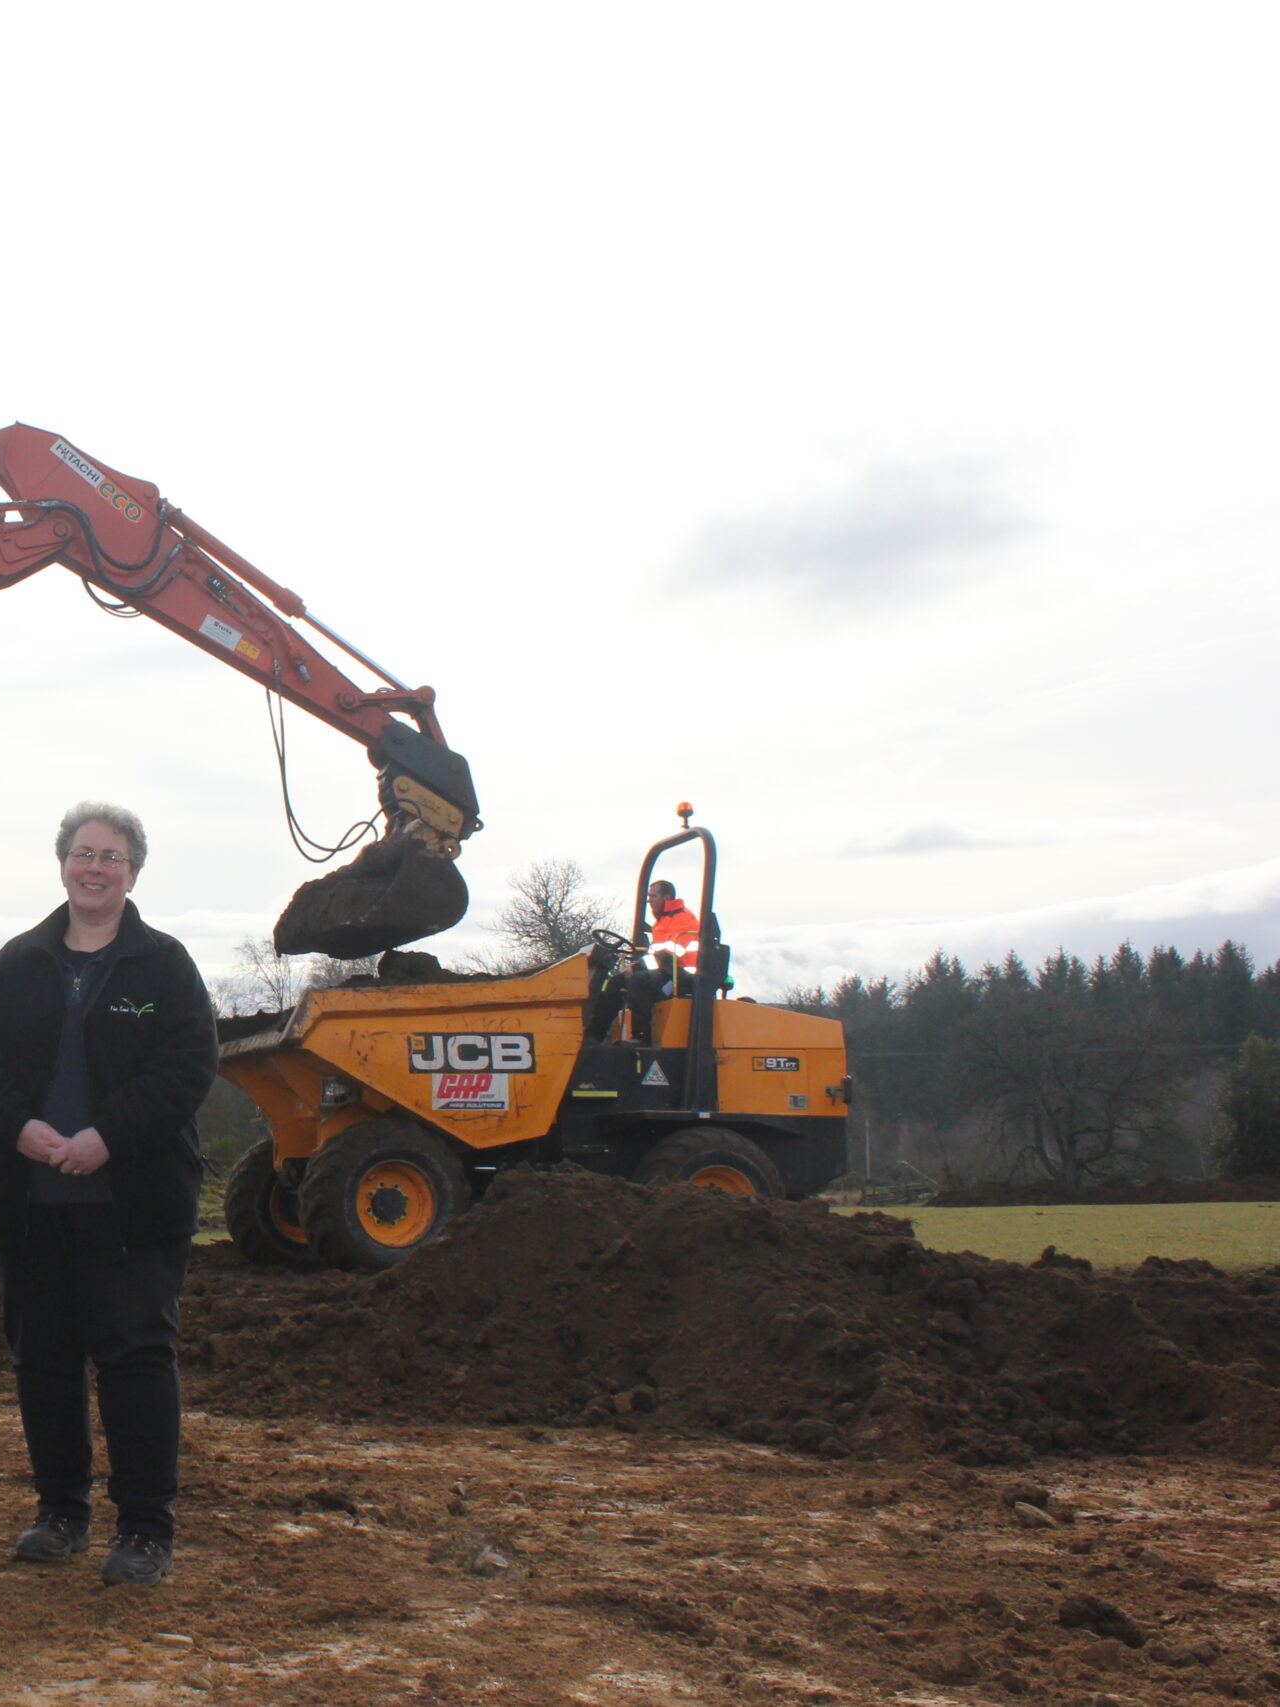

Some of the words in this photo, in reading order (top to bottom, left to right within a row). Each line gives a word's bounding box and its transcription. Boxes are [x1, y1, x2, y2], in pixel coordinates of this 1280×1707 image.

[56, 444, 100, 483] HITACHI
[412, 1035, 532, 1070] JCB
[437, 1074, 493, 1099] GAP
